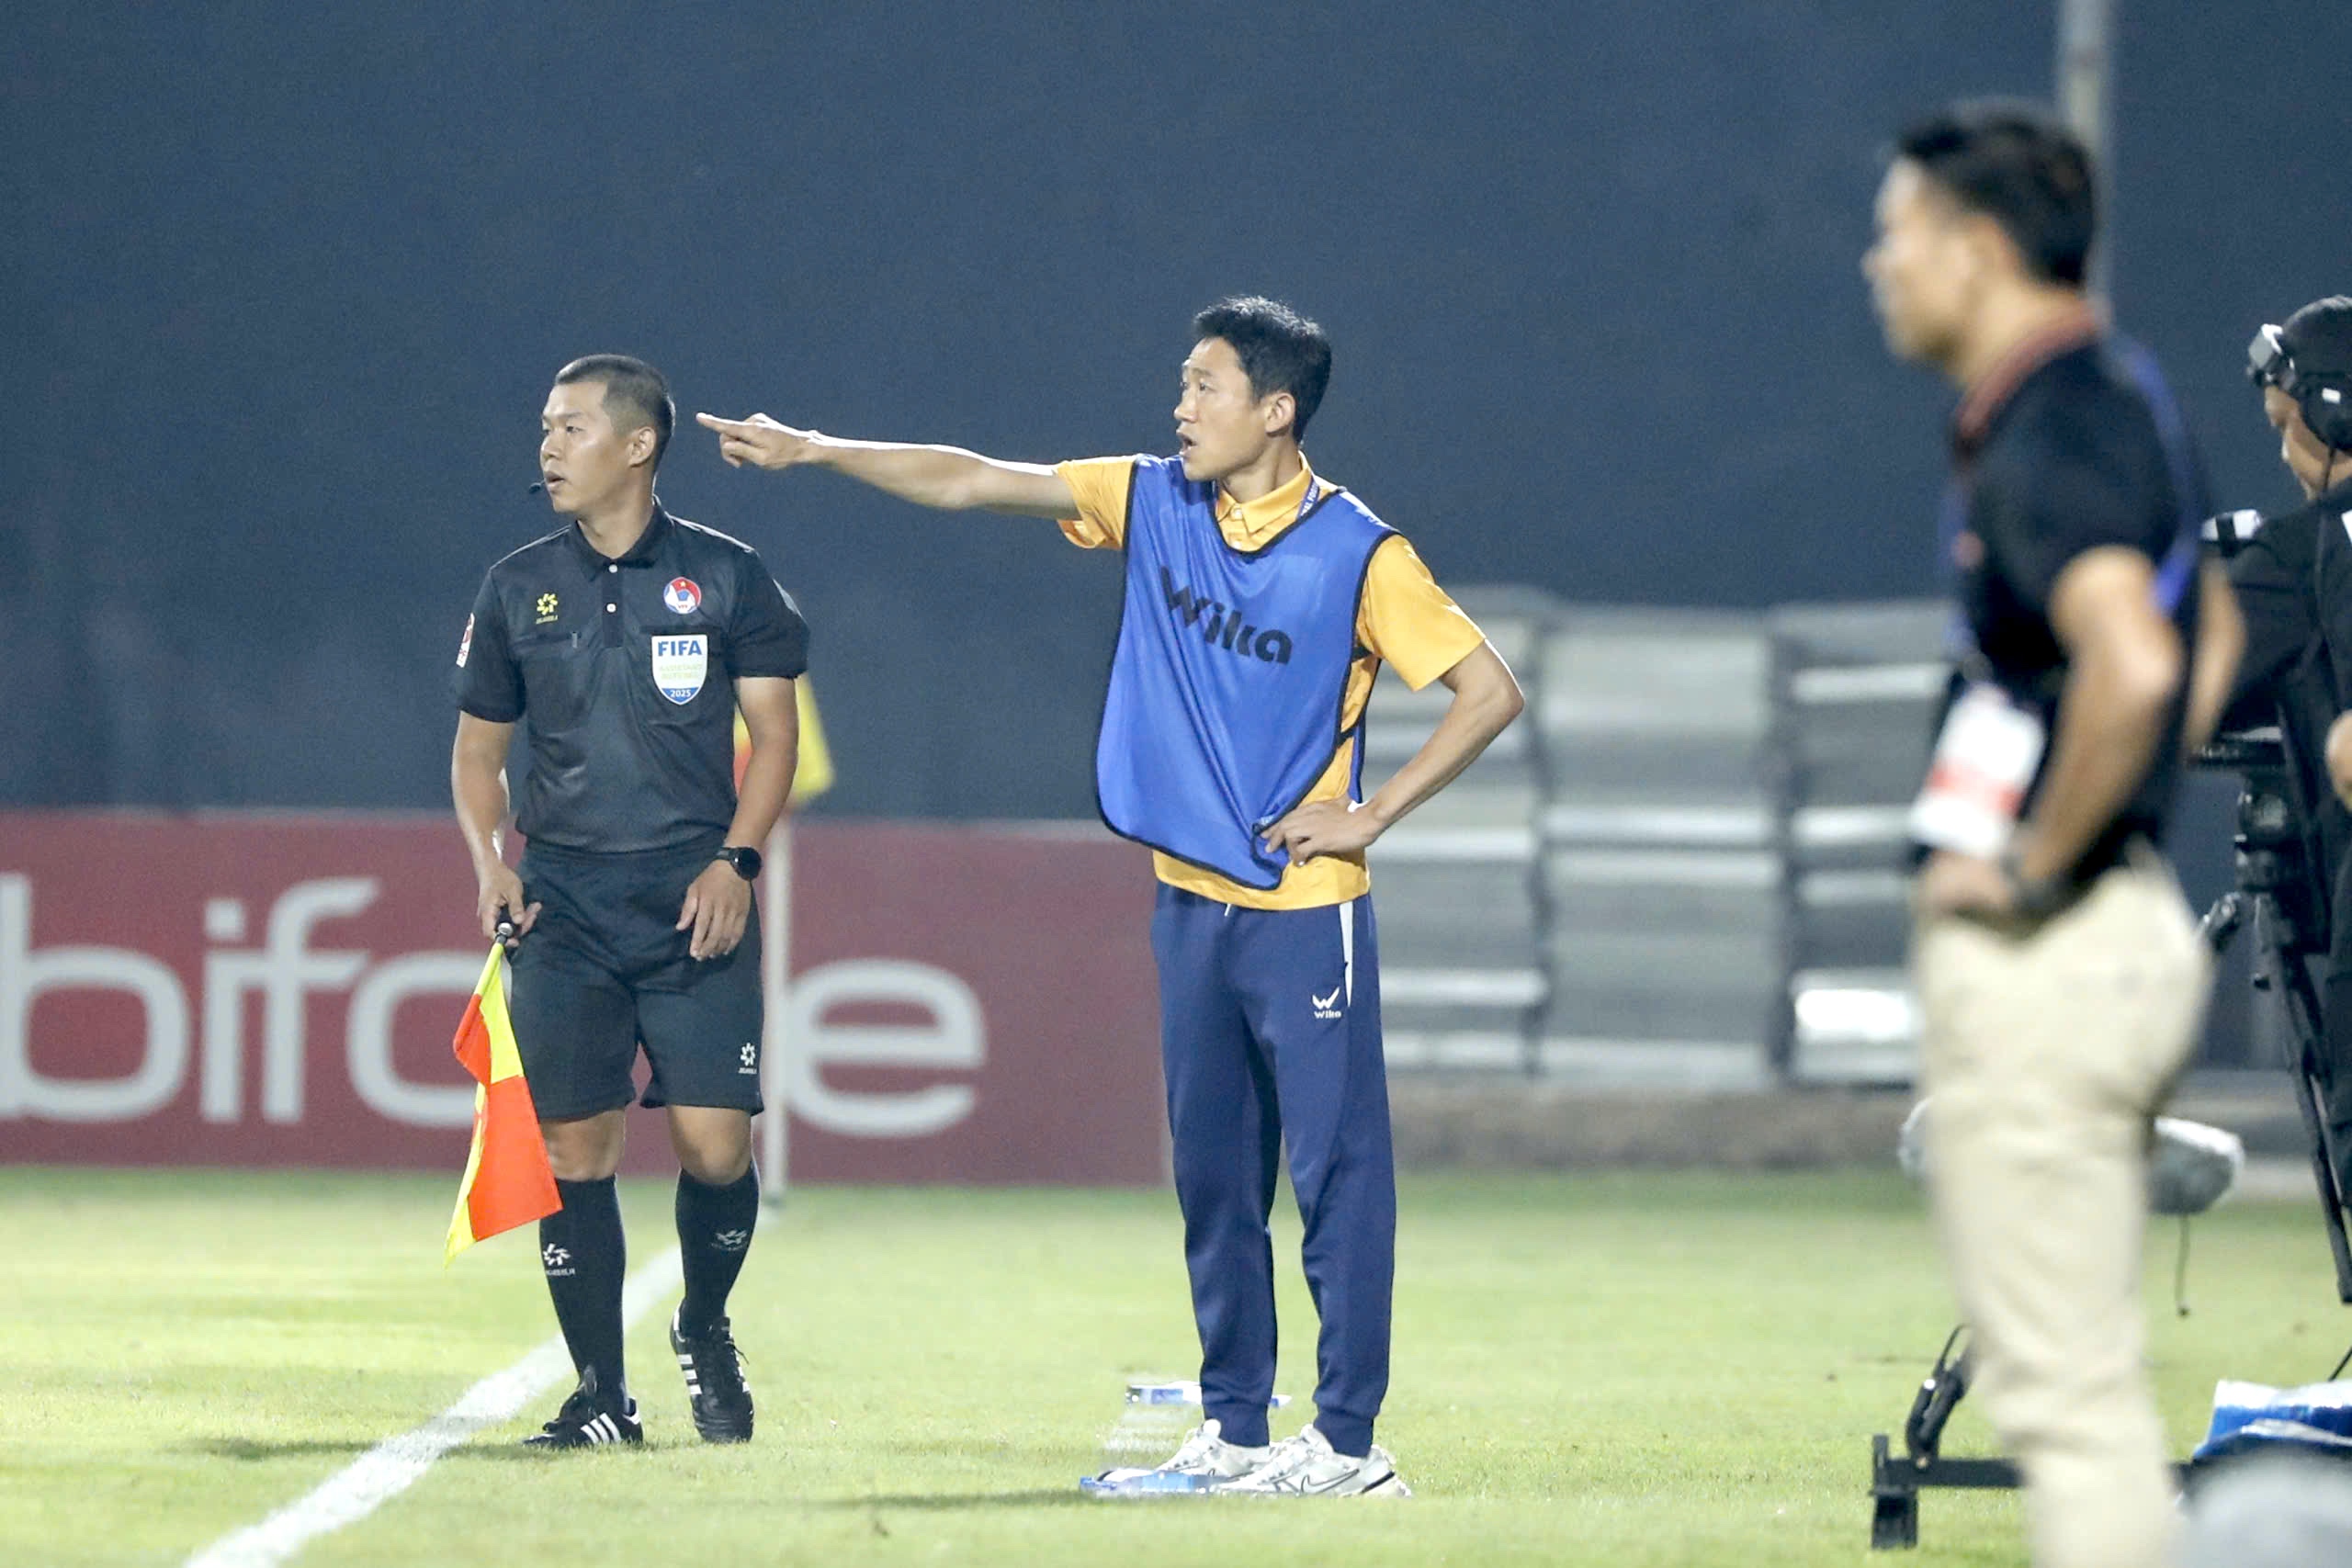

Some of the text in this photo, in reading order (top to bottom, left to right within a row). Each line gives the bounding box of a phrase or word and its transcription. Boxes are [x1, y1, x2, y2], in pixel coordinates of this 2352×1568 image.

[658, 639, 702, 657] FIFA
[670, 689, 692, 698] 2025
[0, 873, 987, 1139] bifoe
